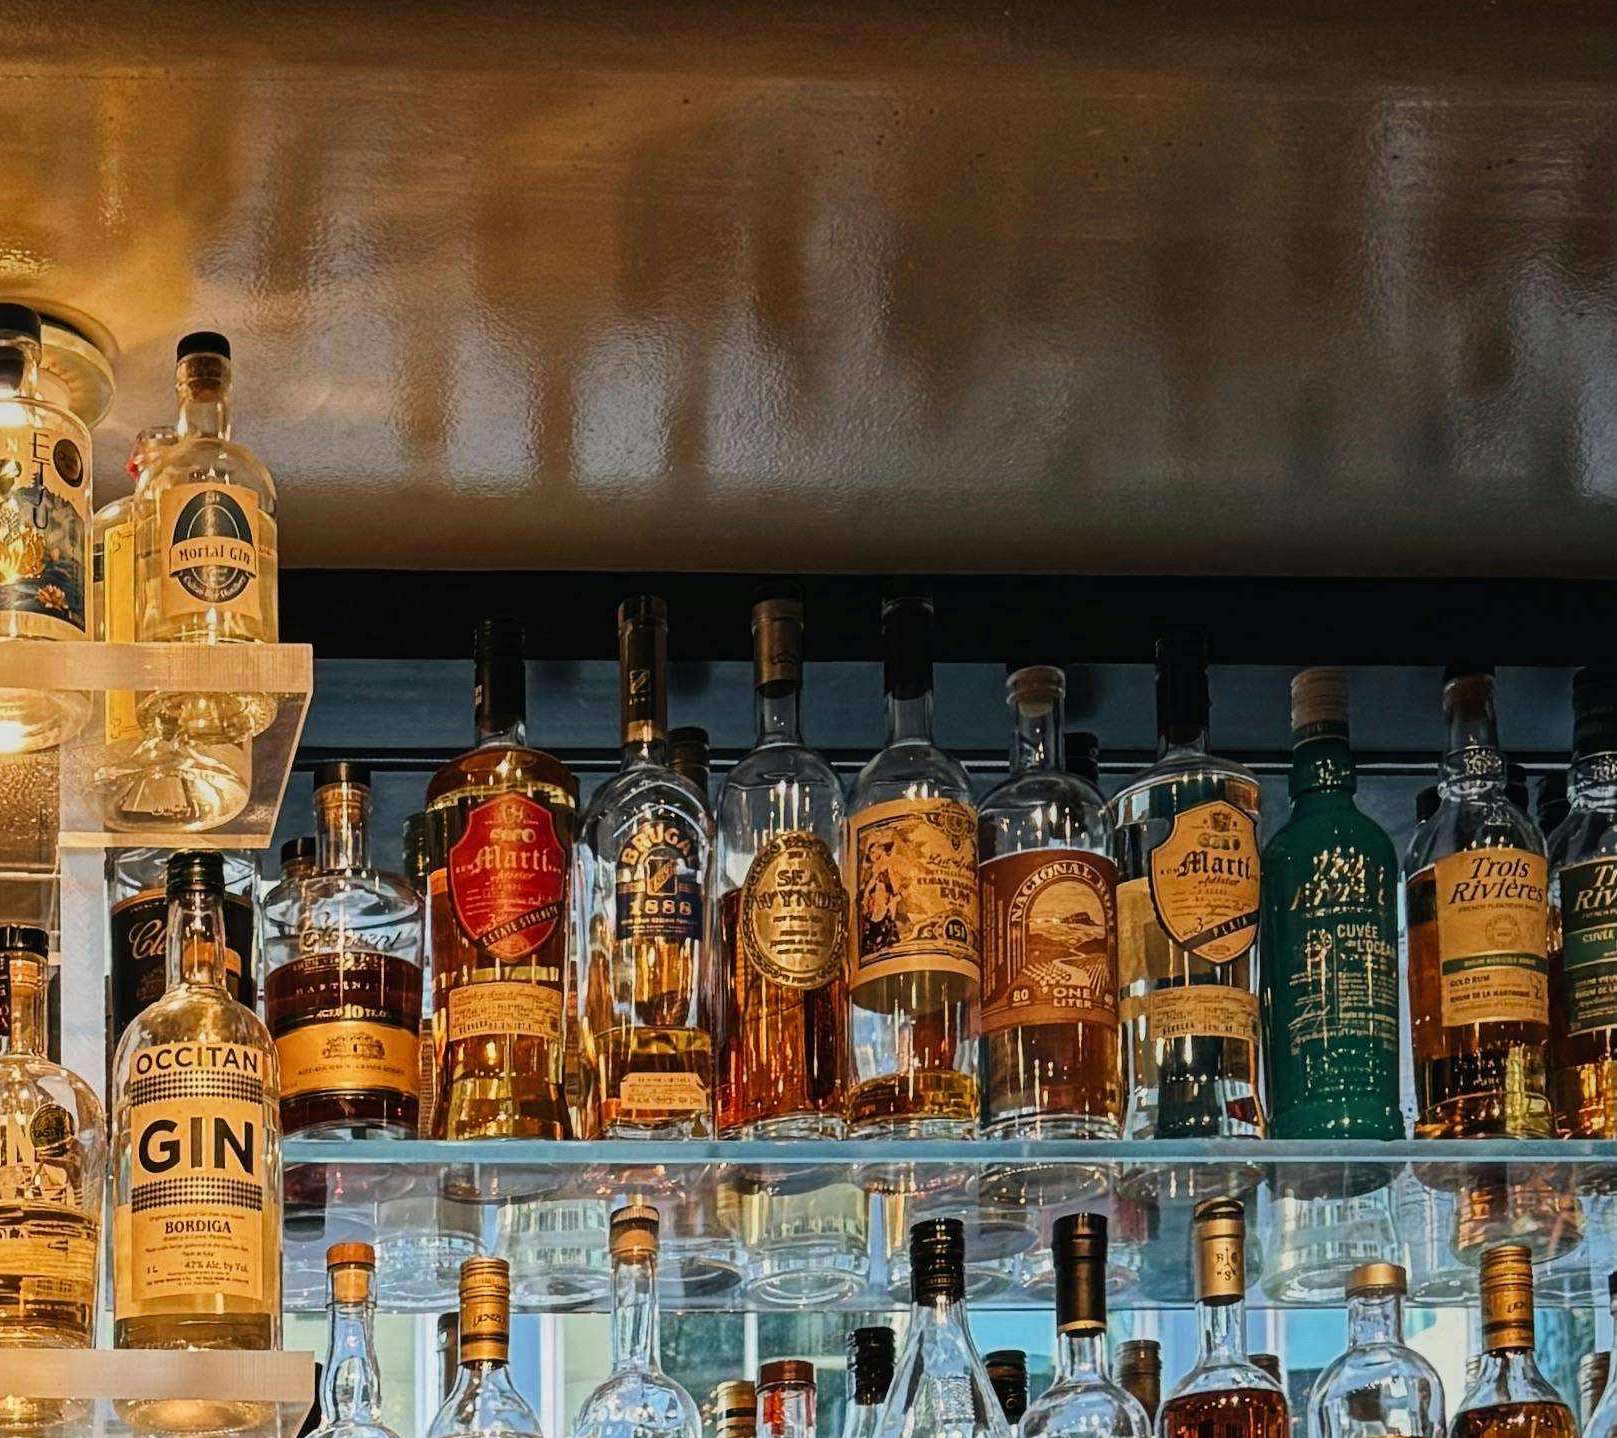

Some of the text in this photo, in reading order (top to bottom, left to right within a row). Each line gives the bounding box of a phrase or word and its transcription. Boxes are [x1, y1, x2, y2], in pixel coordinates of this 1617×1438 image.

[1471, 858, 1530, 879] Trois
[1449, 879, 1545, 904] Rivières
[949, 924, 965, 937] 151
[1053, 988, 1092, 999] ONE
[1053, 999, 1092, 1009] LITER
[135, 1045, 258, 1077] OCCITAN
[138, 1117, 254, 1176] GIN
[165, 1220, 232, 1234] BORDIGA
